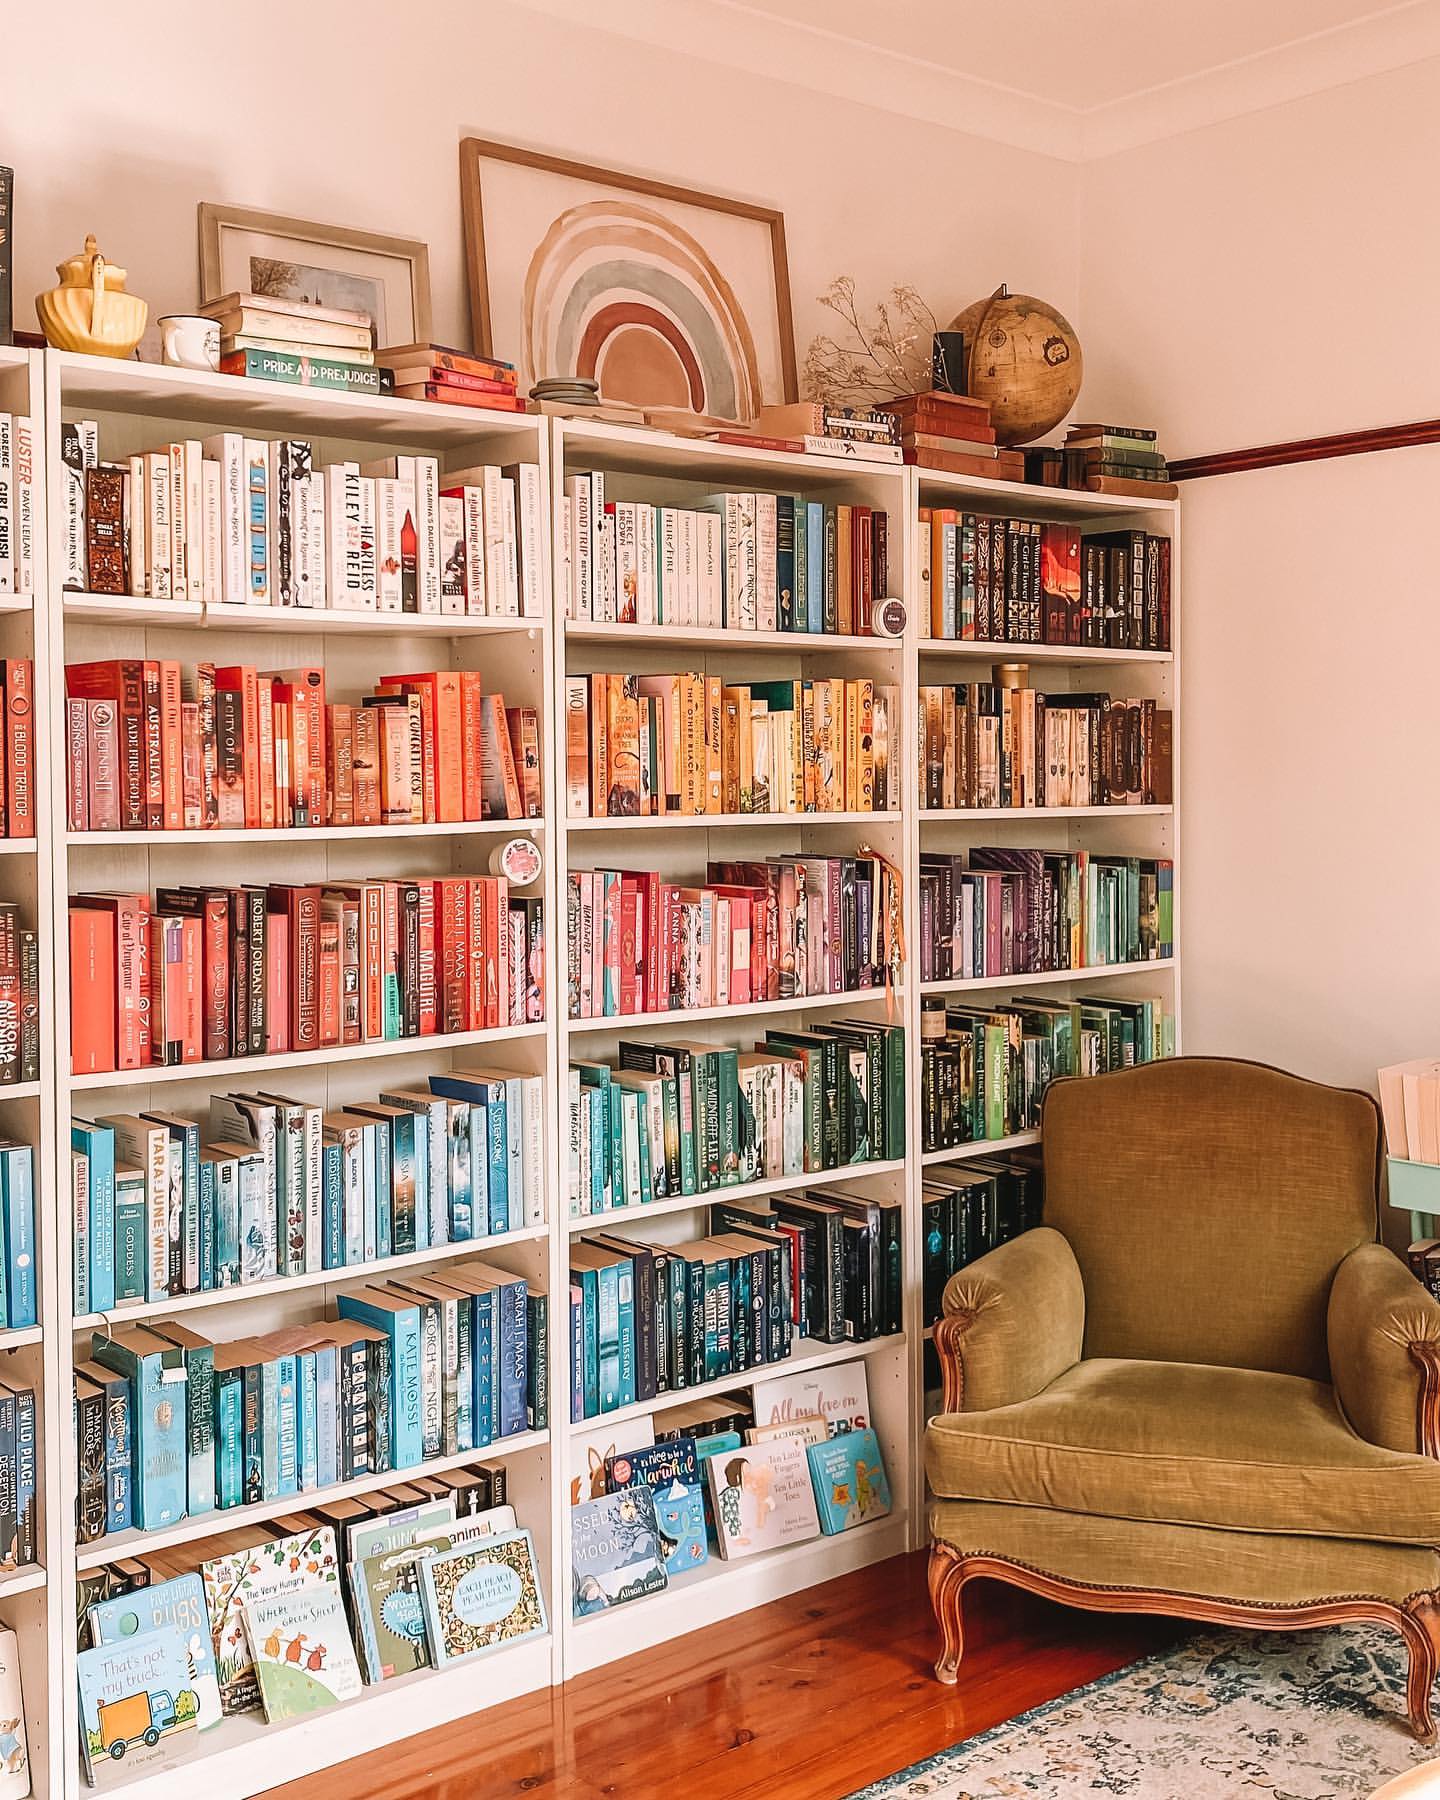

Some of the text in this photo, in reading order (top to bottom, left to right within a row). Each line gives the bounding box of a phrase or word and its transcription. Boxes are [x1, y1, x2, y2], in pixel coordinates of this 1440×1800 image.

[263, 360, 377, 385] PRIDE AND PREJUDICE
[19, 427, 31, 485] LUSTER
[22, 489, 30, 521] RAVEN
[69, 495, 77, 516] NEW
[152, 467, 168, 525] Uprooted
[426, 483, 434, 524] TSARINA'S
[728, 504, 736, 534] PAPER
[0, 516, 8, 559] CRUSH
[346, 474, 360, 589] KILEY REID
[468, 499, 479, 543] gathering
[580, 497, 588, 556] ROAD TRIP
[427, 526, 435, 568] DAUGHTER
[747, 574, 755, 607] PRINCE
[204, 680, 212, 705] PEGGY
[310, 692, 318, 739] STARDUST
[72, 703, 80, 756] EDDINGS
[148, 706, 160, 798] AUSTRALIANA
[226, 705, 235, 783] CITY OF LIES
[296, 714, 305, 745] LOLA
[15, 732, 26, 816] BLOOD TRAITOR
[94, 729, 111, 780] LEGENDS
[127, 718, 140, 810] JADE GOLD
[343, 739, 351, 769] BLOOD
[393, 744, 401, 783] TIGANA
[410, 715, 421, 796] CONCRETE ROSE
[455, 884, 465, 927] SARAH
[122, 911, 135, 990] City of Vengeance
[251, 898, 262, 993] ROBERT JORDAN
[370, 894, 378, 976] BOOTH
[420, 887, 434, 1015] EMILY MAGUIRE
[445, 951, 454, 977] CITY
[455, 941, 465, 978] MAAS
[7, 1000, 16, 1063] AURORA
[490, 1107, 503, 1164] SISTERSONG
[708, 1087, 717, 1161] MIDNIGHT LIE
[78, 1162, 86, 1198] COLLEEN
[311, 1115, 320, 1216] Girl, Serpent, Thorn
[329, 1150, 338, 1199] EDDINGS
[153, 1133, 164, 1291] TARA JUNE WINCH
[202, 1168, 210, 1211] EDDINGS
[126, 1226, 135, 1276] GODDESS
[514, 1285, 524, 1379] SARAH J. MAAS
[706, 1289, 716, 1332] SHATTER
[718, 1282, 729, 1352] UNRAVEL ME
[353, 1363, 366, 1434] CARAVAL
[407, 1332, 418, 1431] KATE MOSSE
[427, 1318, 437, 1437] TORCH NIGHT
[84, 1407, 94, 1456] MIRRORS
[770, 1392, 840, 1424] All love
[21, 1408, 33, 1487] WILD PLACE
[280, 1403, 295, 1481] AMERICAN DIRT
[649, 1450, 667, 1465] nice
[784, 1448, 800, 1461] Little
[0, 1455, 9, 1516] DECEPTION
[637, 1456, 694, 1485] Narwhal
[788, 1479, 808, 1490] Little
[783, 1493, 800, 1502] Toes
[575, 1538, 620, 1561] MOON
[246, 1576, 305, 1600] The Very Hungry
[620, 1578, 665, 1599] Alison Lester
[256, 1606, 288, 1623] WHERE
[101, 1647, 167, 1678] That's not
[102, 1679, 122, 1697] my
